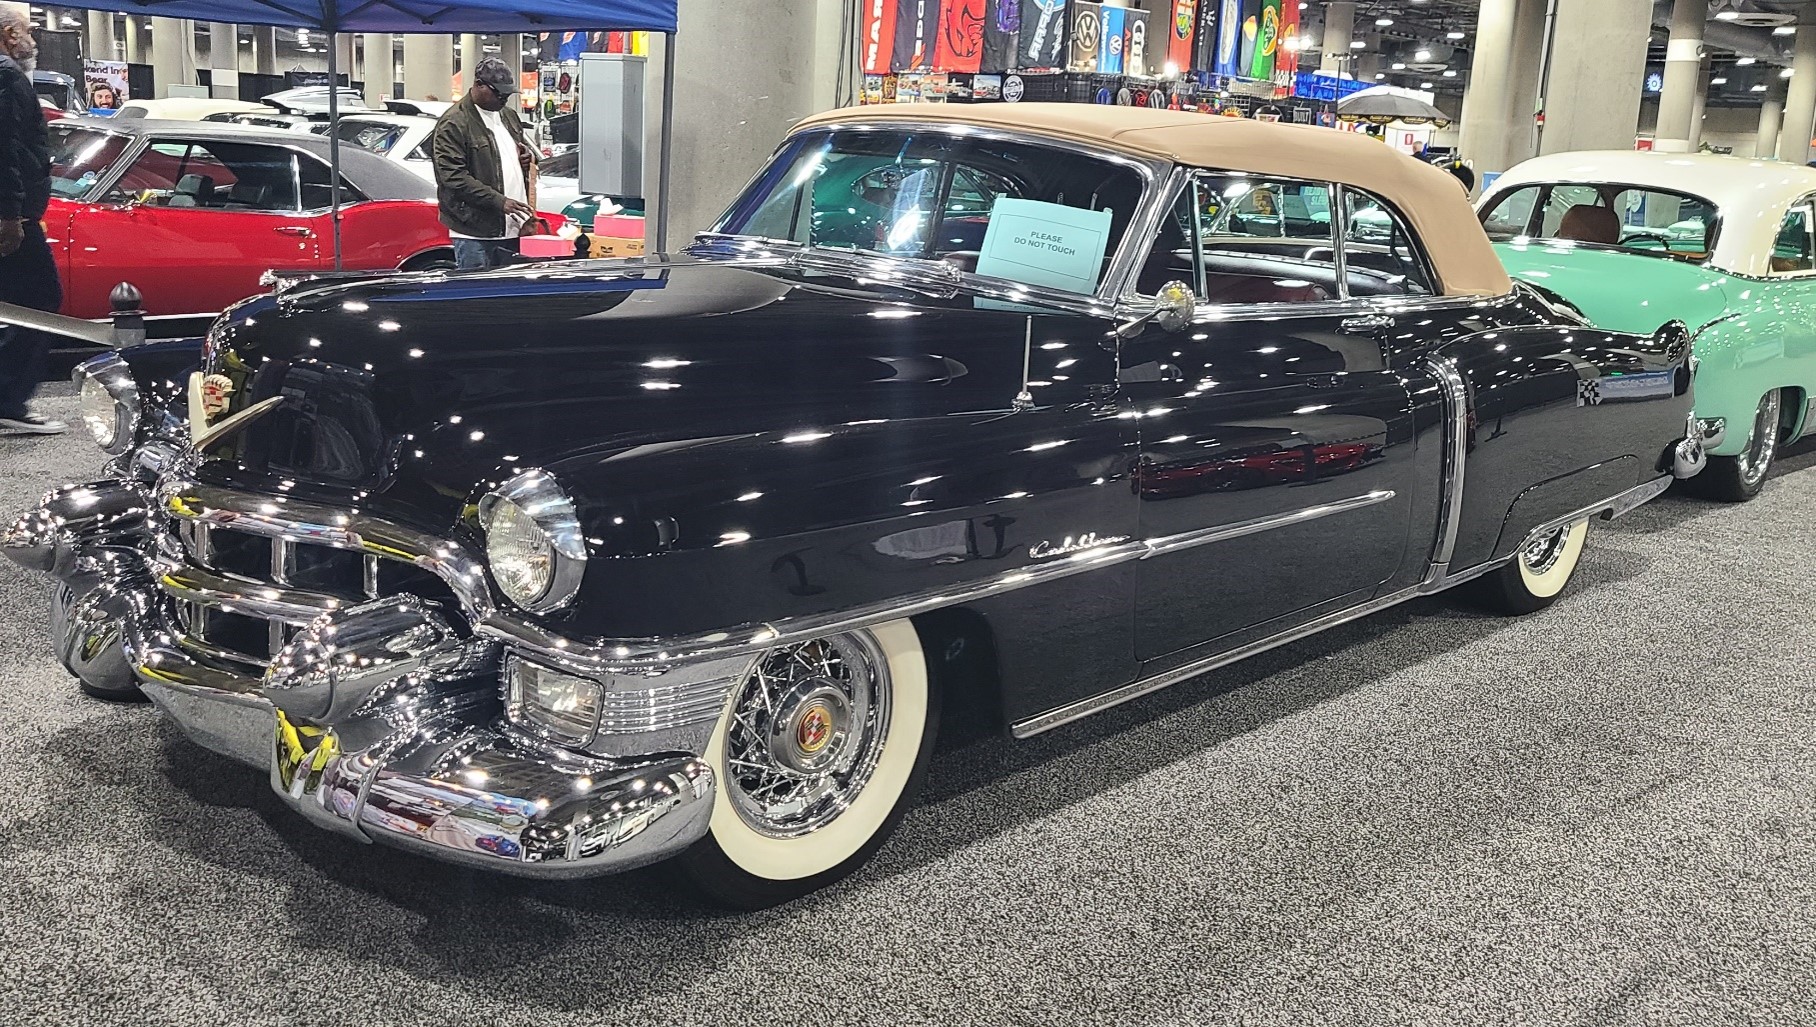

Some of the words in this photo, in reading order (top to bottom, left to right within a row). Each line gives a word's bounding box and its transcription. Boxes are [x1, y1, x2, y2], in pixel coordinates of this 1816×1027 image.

[1031, 231, 1063, 243] PLEASE
[1014, 236, 1026, 246] DO
[1028, 239, 1045, 249] NOT
[1047, 243, 1076, 256] TOUCH
